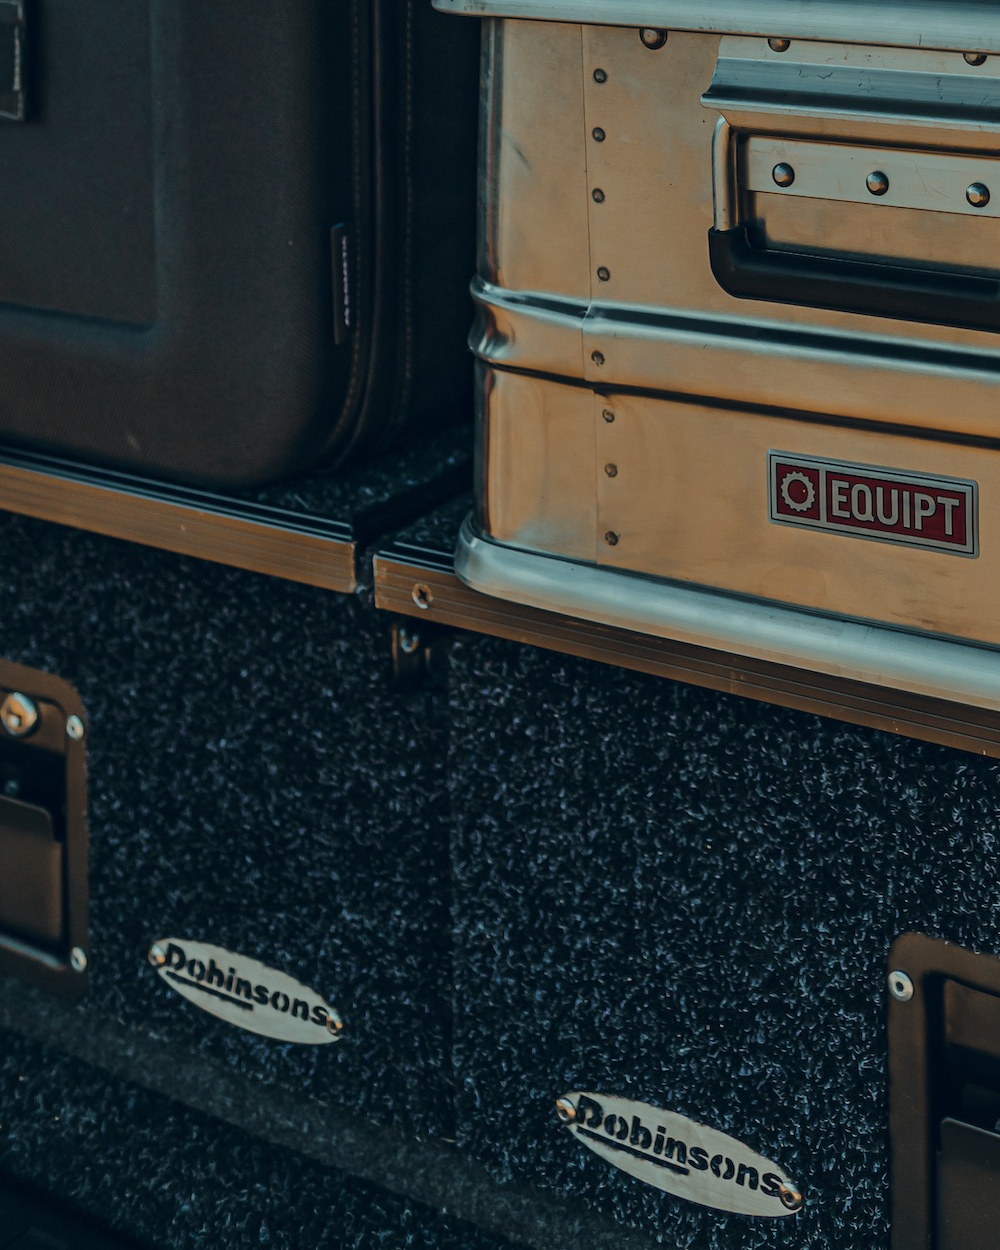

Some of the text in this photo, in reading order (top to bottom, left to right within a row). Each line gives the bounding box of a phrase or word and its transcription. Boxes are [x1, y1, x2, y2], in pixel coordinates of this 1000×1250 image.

[831, 479, 960, 536] EQUIPT
[165, 943, 330, 1026] Dobinsons
[576, 1094, 784, 1197] Dobinsons
